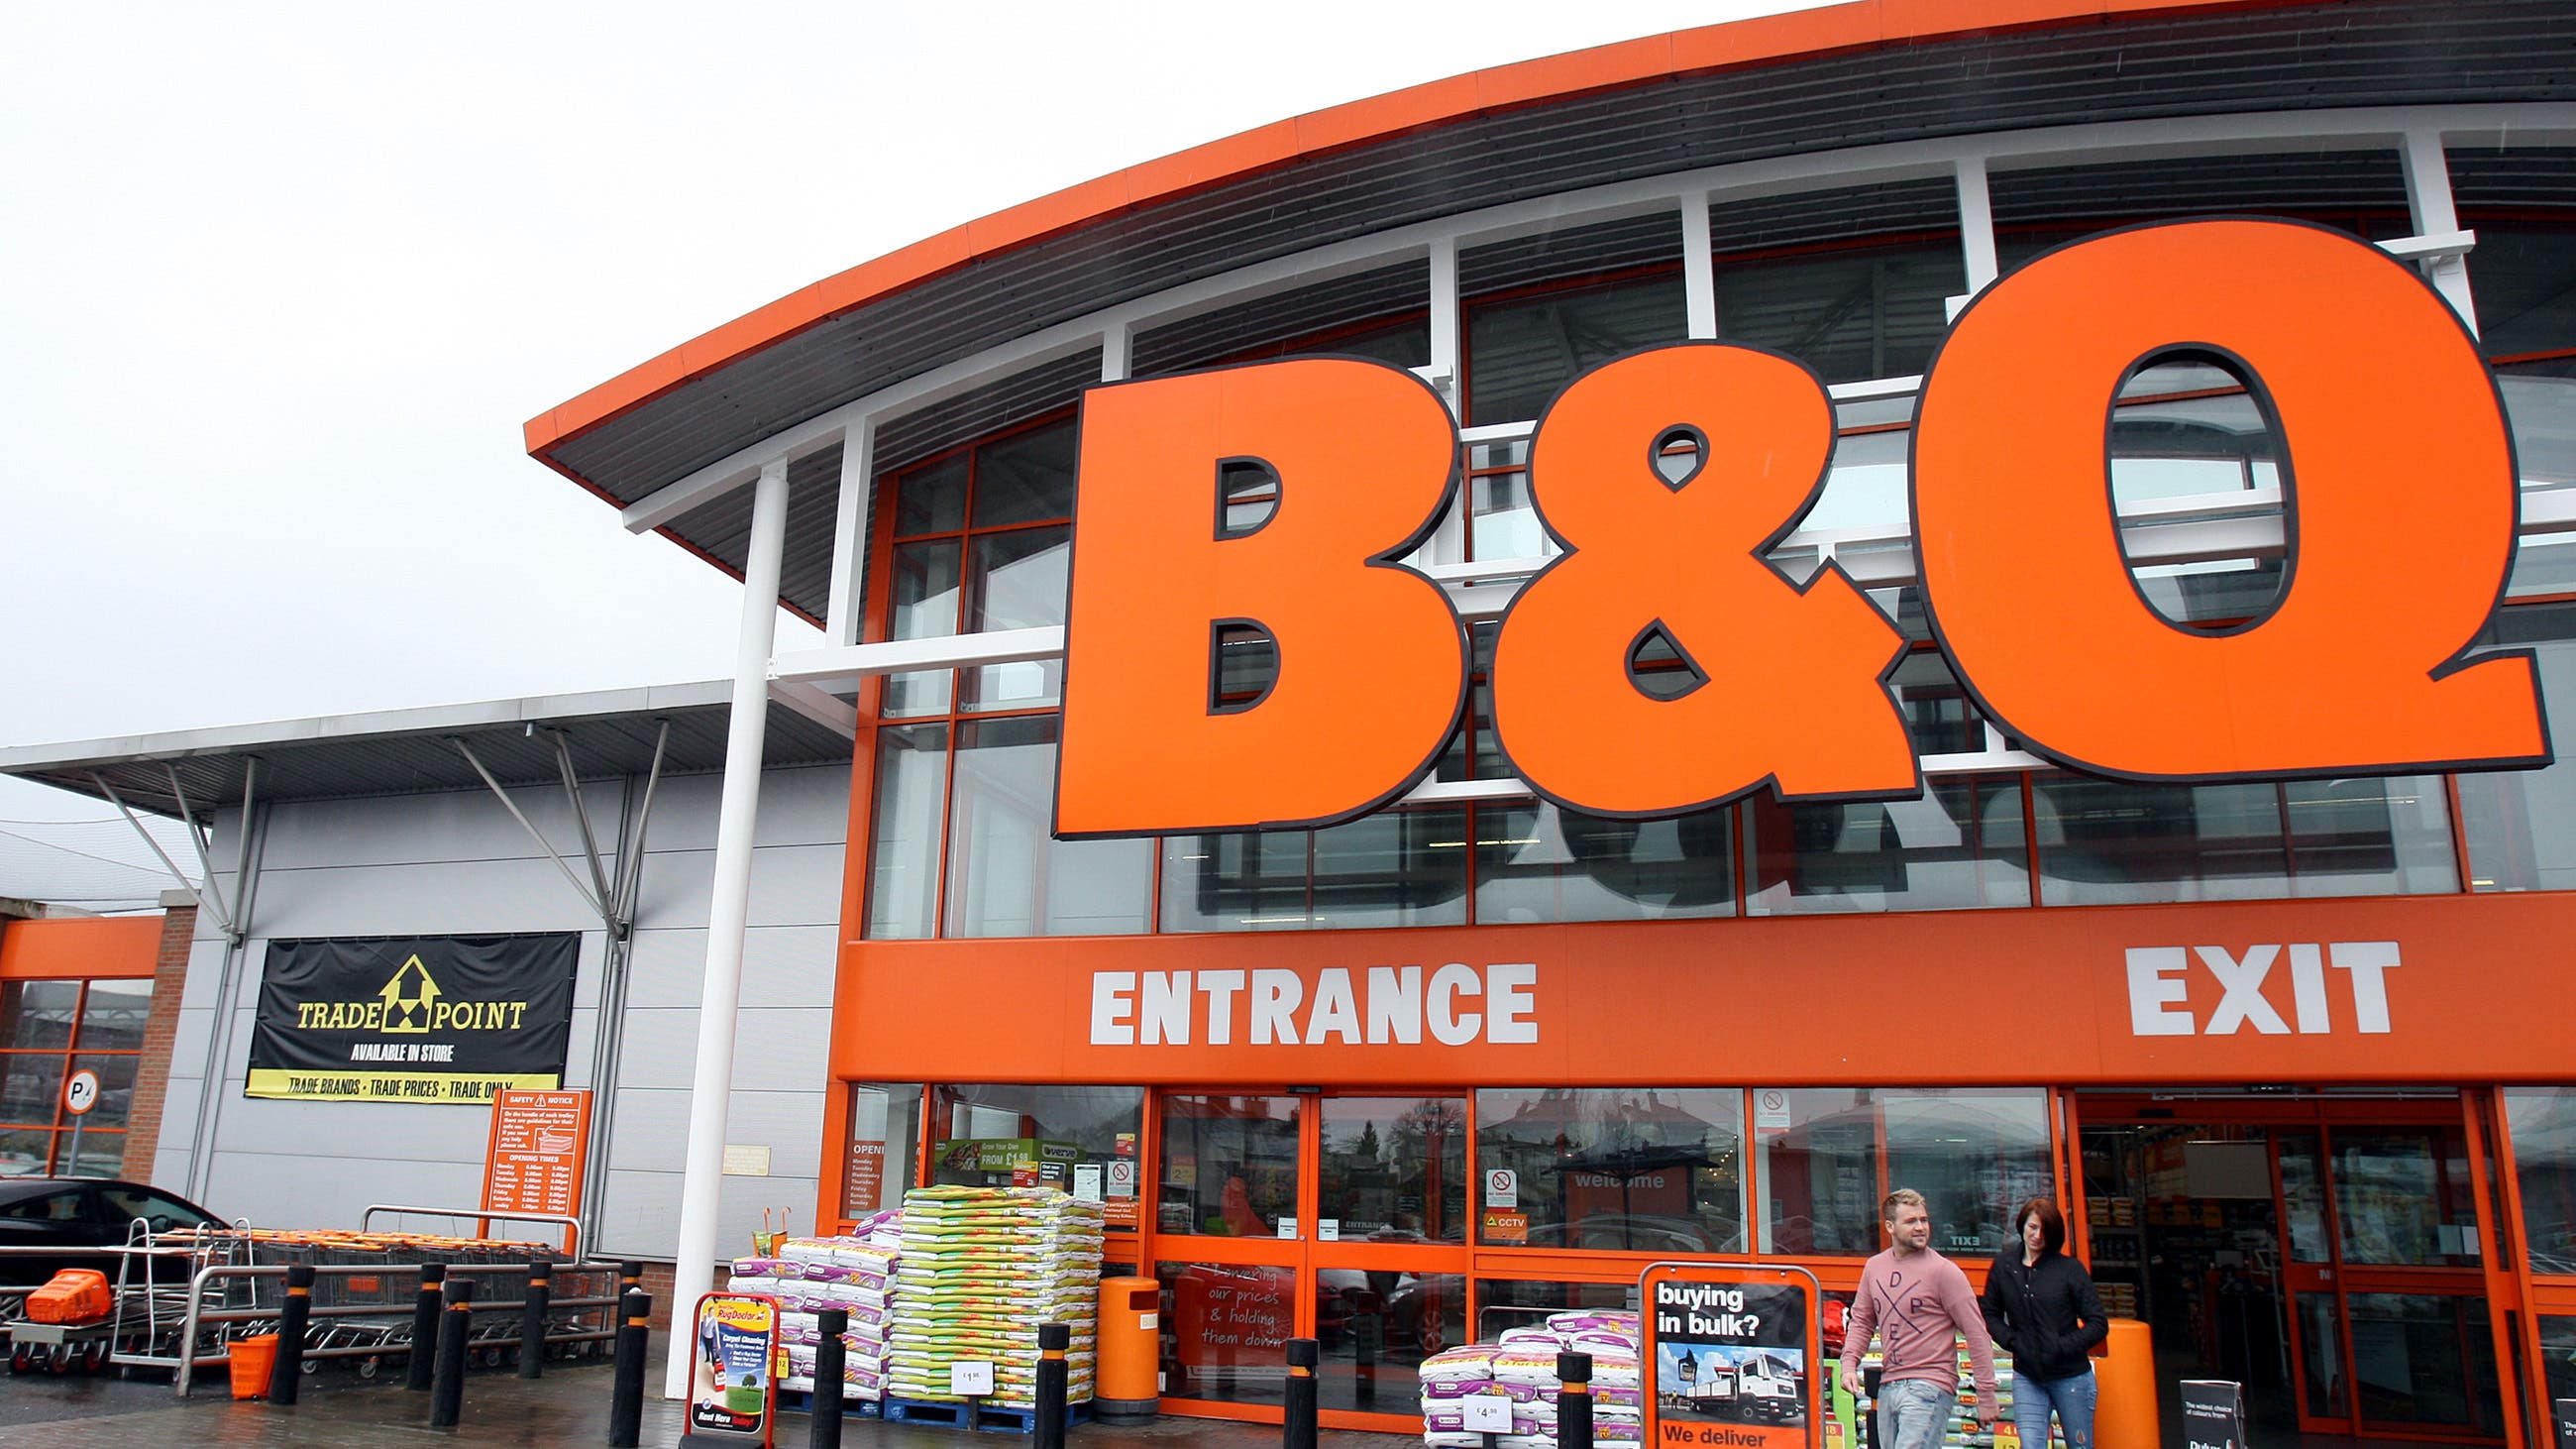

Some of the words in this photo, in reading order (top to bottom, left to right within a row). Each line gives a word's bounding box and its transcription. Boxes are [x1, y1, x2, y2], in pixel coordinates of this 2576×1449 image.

[1054, 213, 2552, 838] B&Q
[2125, 940, 2402, 1037] EXIT
[1090, 961, 1539, 1047] ENTRANCE
[297, 1001, 381, 1030] TRADE
[433, 1001, 528, 1030] POINT
[350, 1044, 406, 1062] AVAILABLE
[407, 1044, 420, 1061] IN
[420, 1044, 455, 1063] STORE
[70, 1082, 83, 1100] P
[288, 1077, 318, 1093] TRADE
[320, 1077, 362, 1095] BRANDS
[370, 1079, 401, 1096] TRADE
[403, 1079, 439, 1097] PRICES
[450, 1080, 482, 1098] TRADE
[982, 1155, 1003, 1166] FROM
[1498, 1218, 1525, 1227] CCTV
[1213, 1264, 1277, 1290] Lowering
[1889, 1272, 1901, 1287] D
[1209, 1289, 1231, 1299] our
[1236, 1286, 1279, 1308] prices
[1658, 1282, 1744, 1313] buying
[1910, 1297, 1923, 1314] P
[1210, 1307, 1222, 1322] &
[1229, 1308, 1275, 1334] holding
[1658, 1311, 1681, 1333] in
[1688, 1313, 1761, 1337] bulk?
[723, 1334, 741, 1343] Carpet
[741, 1335, 766, 1346] Cleaning
[1202, 1328, 1237, 1344] them
[1245, 1331, 1282, 1348] down
[714, 1413, 731, 1423] Here
[2213, 1404, 2232, 1413] choice
[1664, 1425, 1693, 1443] We
[1700, 1428, 1767, 1447] deliver
